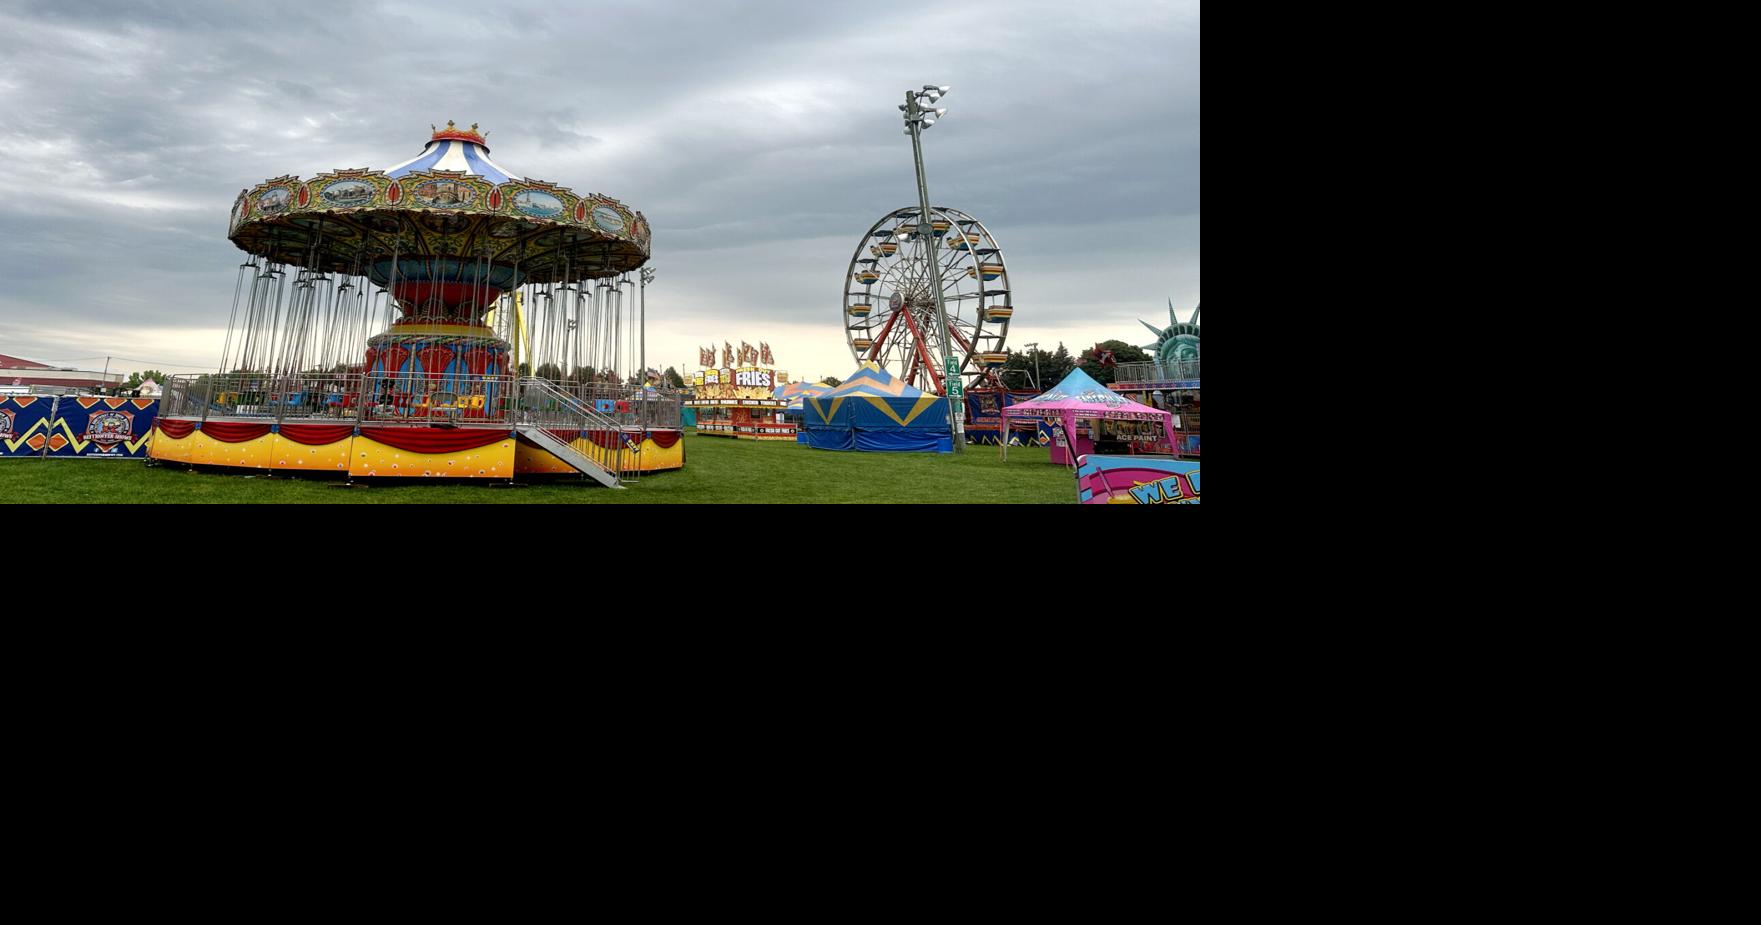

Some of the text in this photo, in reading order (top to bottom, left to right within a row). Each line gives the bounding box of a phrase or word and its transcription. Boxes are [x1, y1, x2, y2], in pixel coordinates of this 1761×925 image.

[736, 371, 771, 387] FRIES
[952, 387, 959, 395] 5
[1129, 475, 1183, 504] WE
